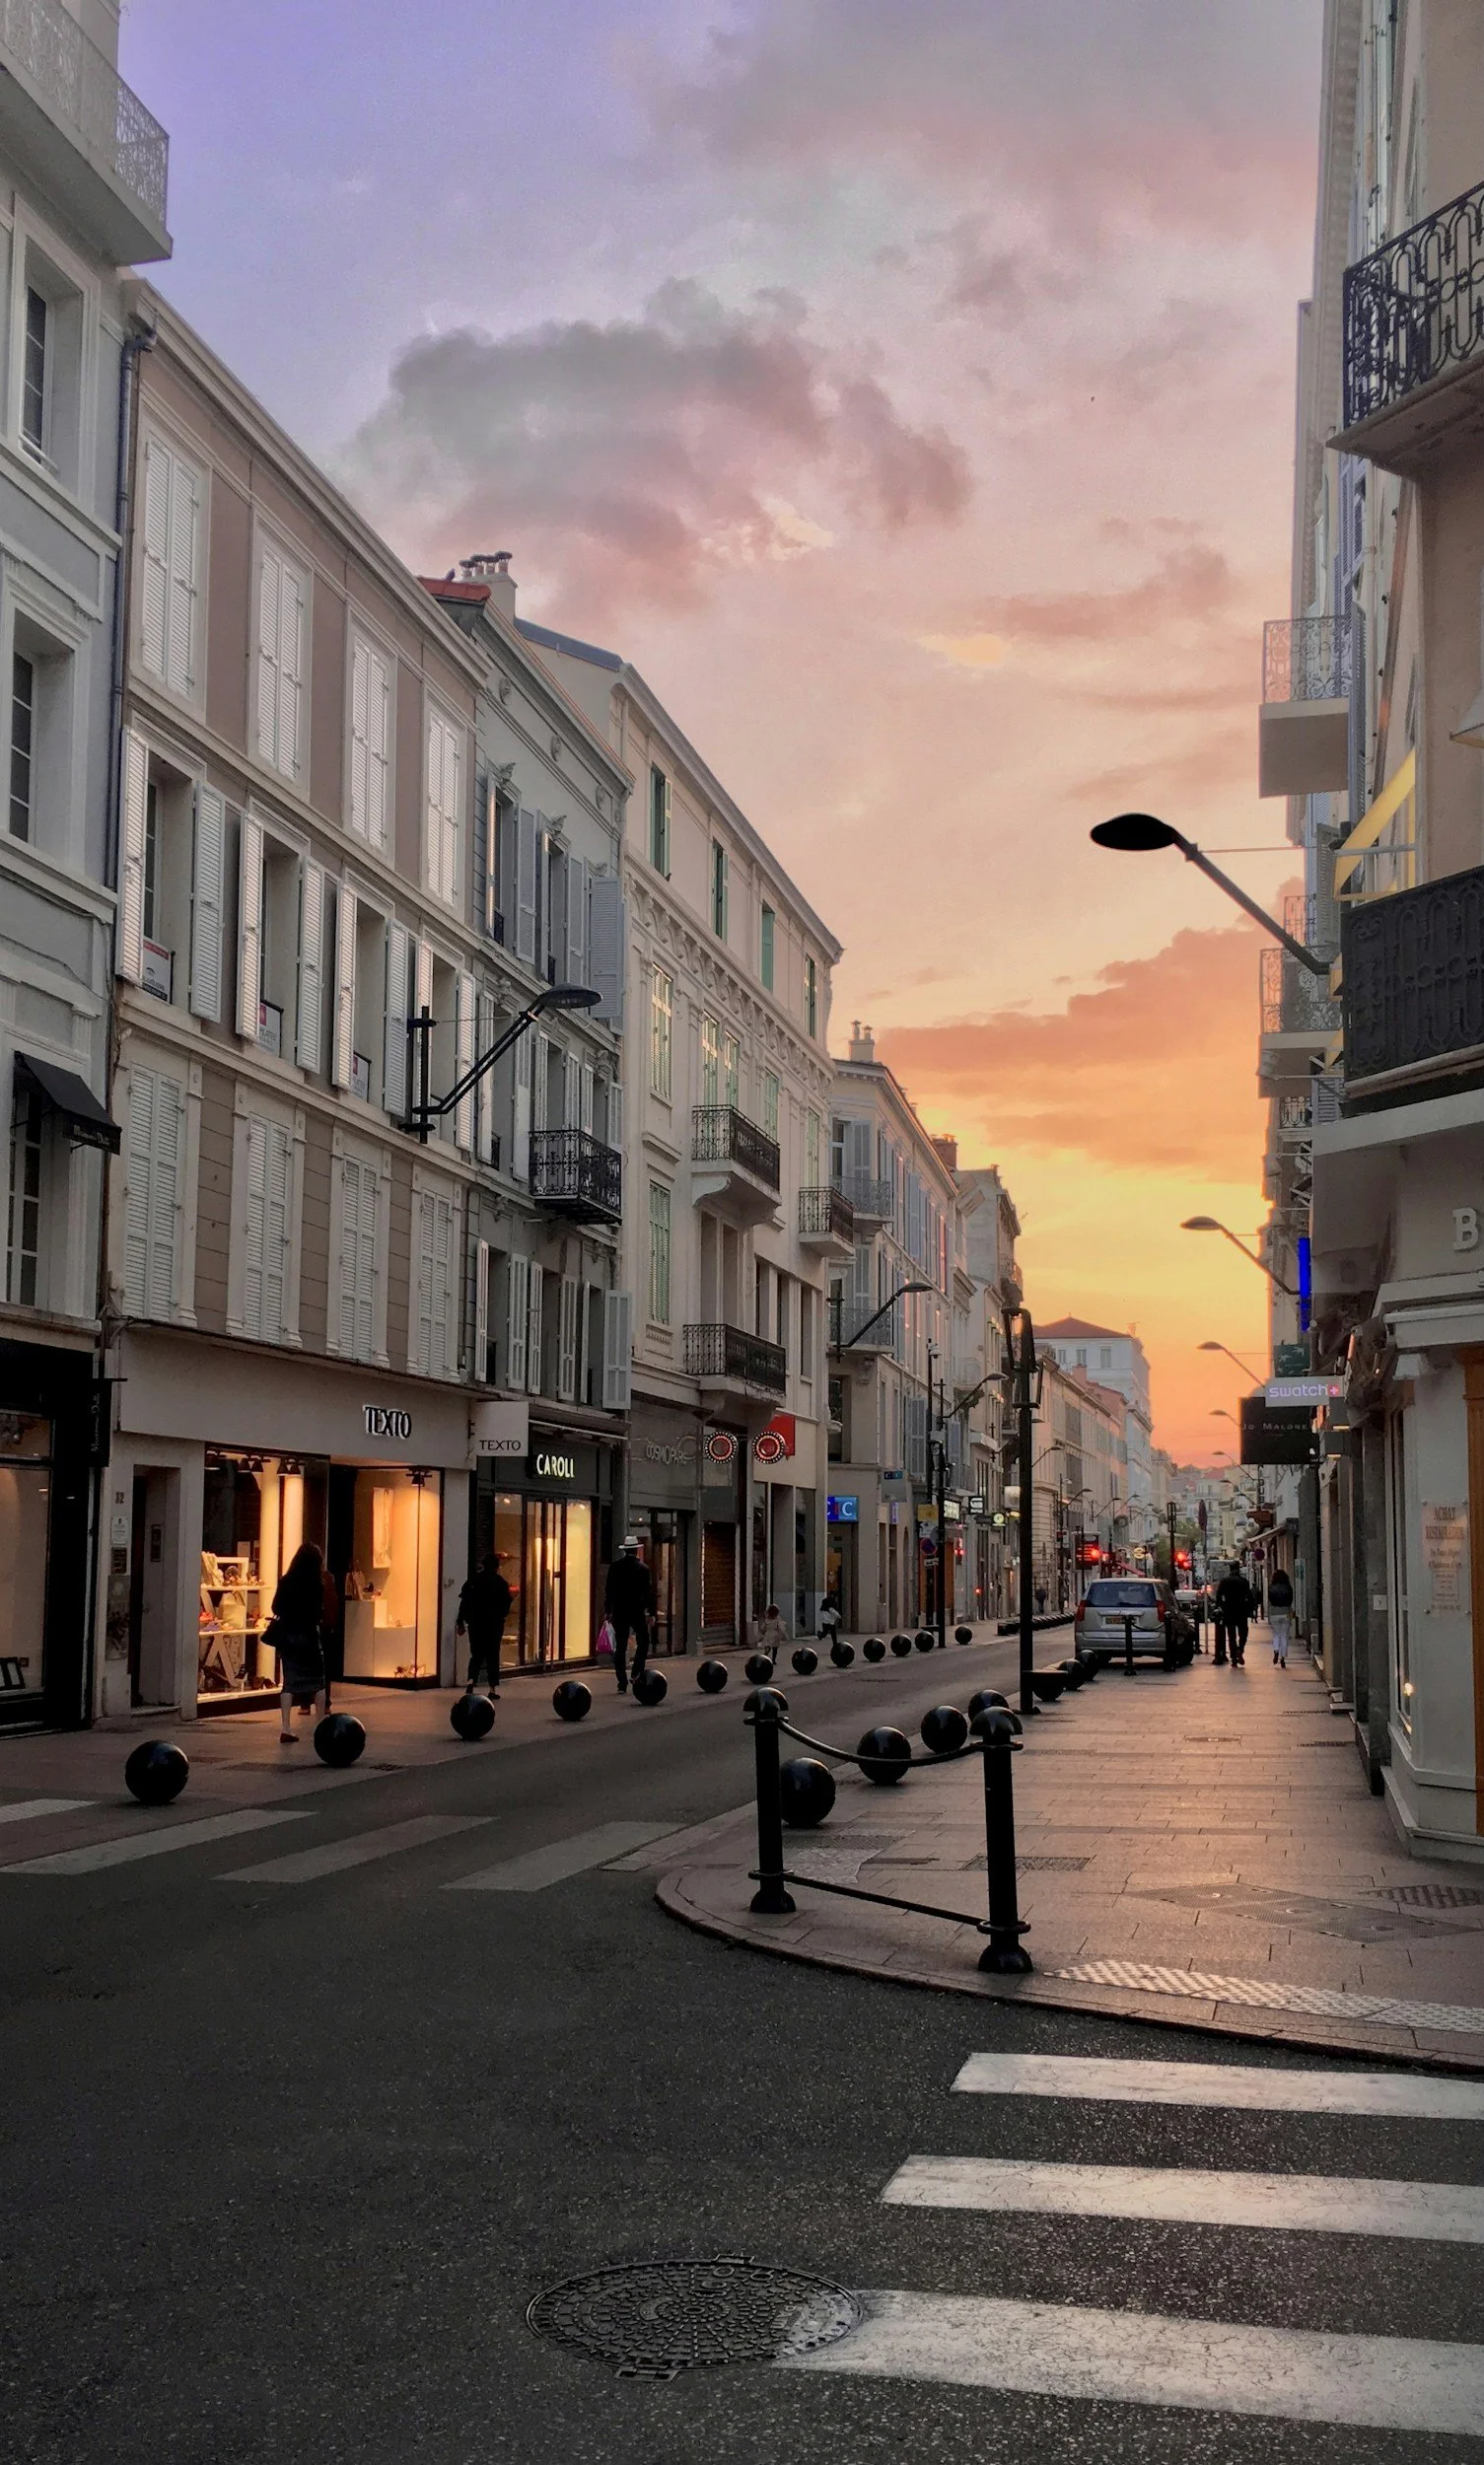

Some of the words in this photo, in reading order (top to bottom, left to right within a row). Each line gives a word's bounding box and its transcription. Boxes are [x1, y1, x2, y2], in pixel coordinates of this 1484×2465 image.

[1452, 1207, 1479, 1251] B
[1269, 1383, 1328, 1397] swatch
[363, 1404, 412, 1439] TEXTO
[479, 1439, 522, 1451] TEXTO
[536, 1453, 575, 1478] CAROLL
